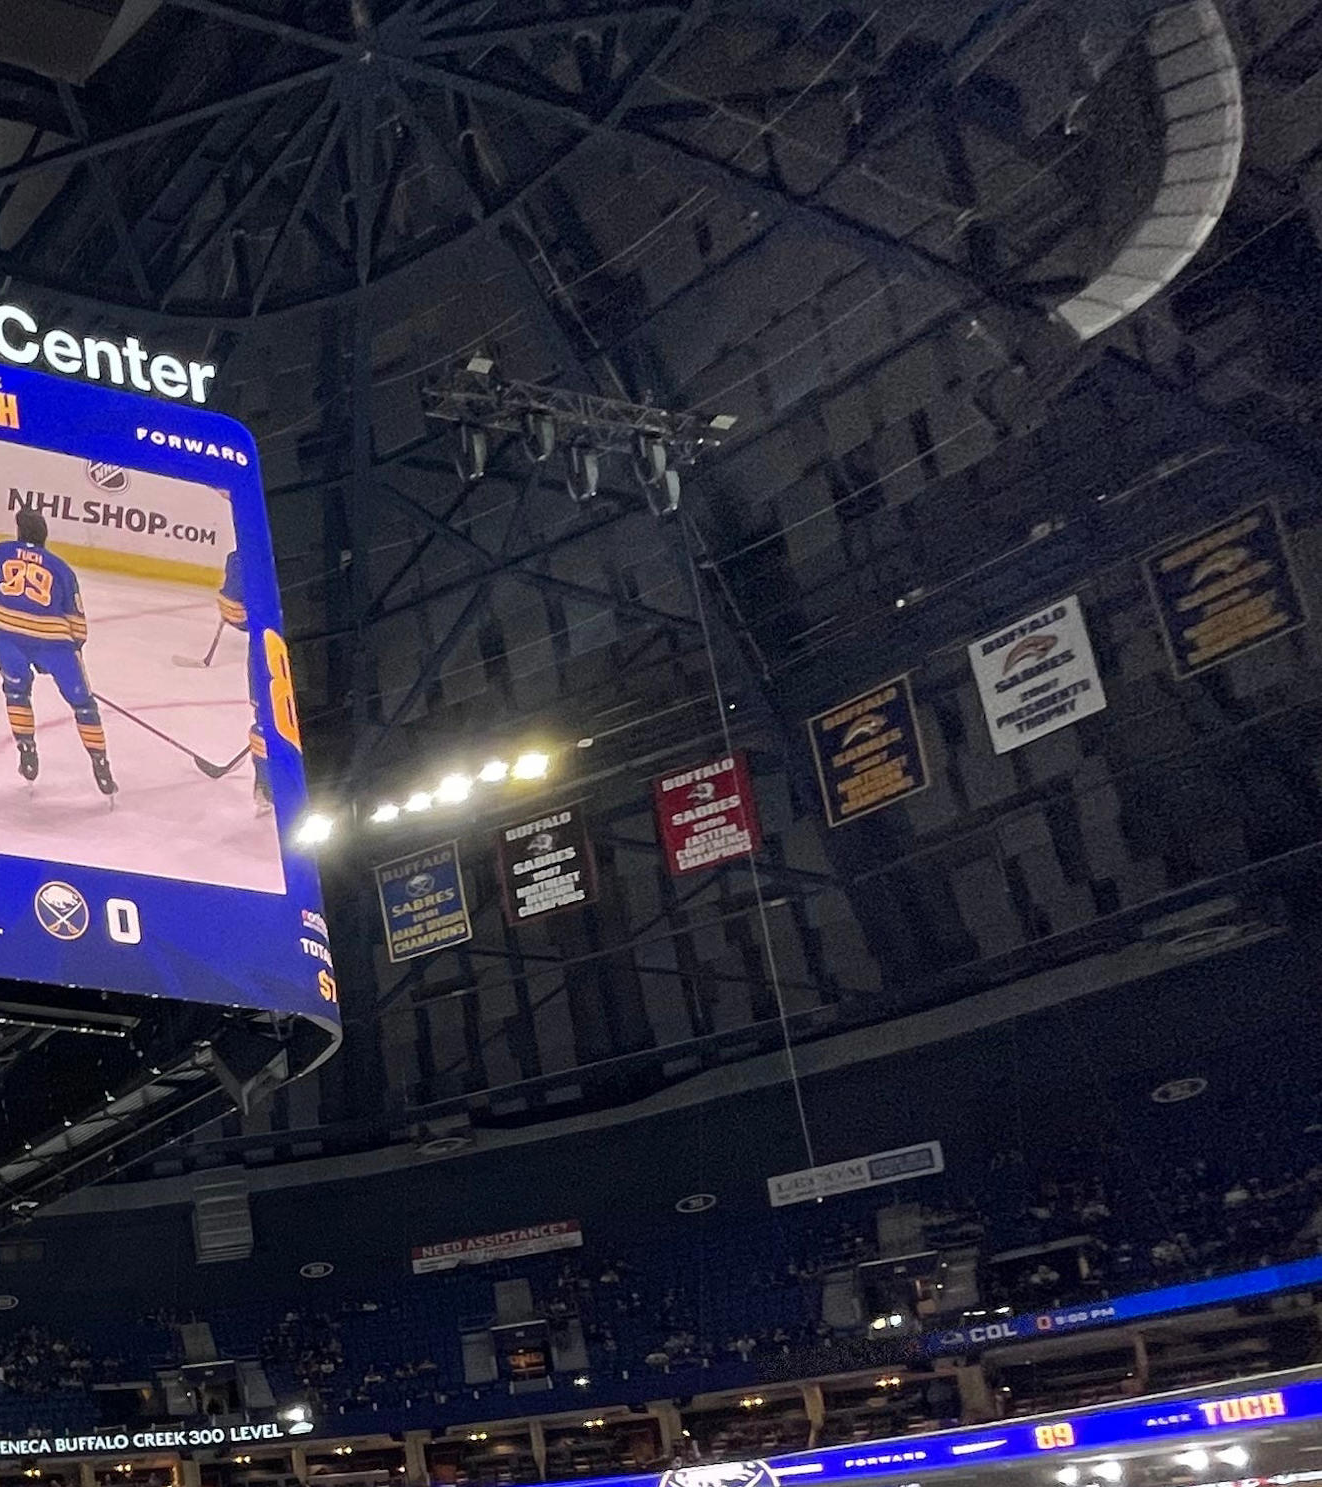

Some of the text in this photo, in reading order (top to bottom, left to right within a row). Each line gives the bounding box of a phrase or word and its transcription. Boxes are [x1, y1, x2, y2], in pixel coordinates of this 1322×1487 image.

[136, 428, 248, 466] FORWARD
[392, 888, 455, 918] SABRES
[105, 898, 141, 945] 0
[970, 1322, 1017, 1343] COL
[1198, 1393, 1285, 1425] TUCH
[55, 1433, 129, 1452] BUFFALO
[133, 1432, 186, 1448] CREEK
[189, 1428, 224, 1444] 300
[230, 1424, 283, 1442] LEVEL
[1035, 1423, 1075, 1450] 89
[844, 1451, 926, 1467] FORWARD
